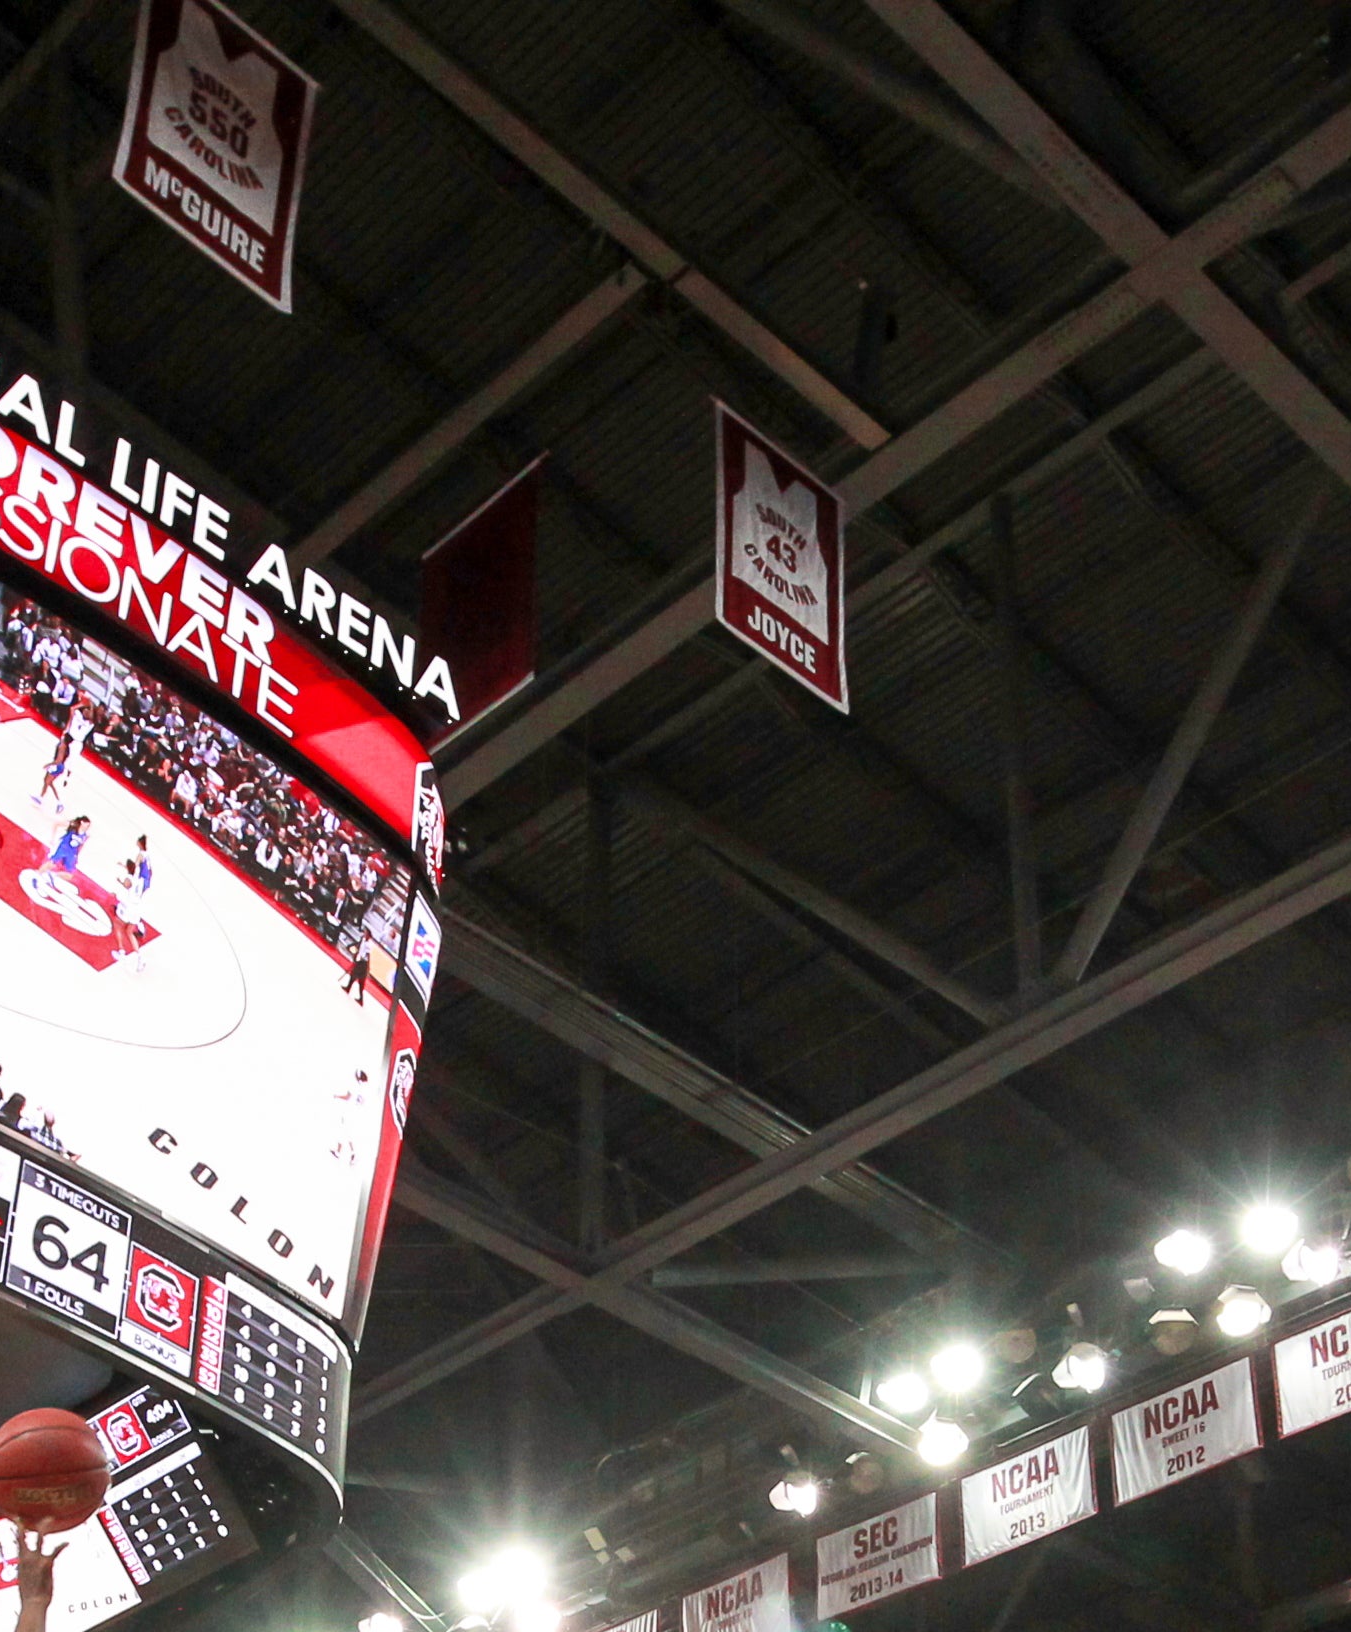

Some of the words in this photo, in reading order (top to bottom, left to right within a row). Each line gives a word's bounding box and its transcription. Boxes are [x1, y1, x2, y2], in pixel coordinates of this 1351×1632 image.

[755, 502, 807, 549] SOUTH
[743, 542, 819, 606] CAROLINA
[766, 534, 797, 574] 43
[111, 437, 230, 562] LIFE
[248, 541, 461, 721] ARENA
[747, 605, 817, 674] JOYCE
[34, 1173, 45, 1188] 3
[50, 1181, 120, 1228] TIMEOUTS
[31, 1214, 109, 1293] 64
[22, 1276, 30, 1290] 1
[34, 1283, 85, 1317] FOULS
[134, 1334, 178, 1366] BONUS
[1143, 1380, 1219, 1439] NCAA
[1161, 1427, 1190, 1448] SWEET
[1194, 1421, 1205, 1434] 16
[992, 1446, 1061, 1503] NCAA
[1167, 1446, 1206, 1476] 2012
[1000, 1484, 1055, 1516] TOURNAMENT
[853, 1516, 898, 1559] SEC
[1010, 1512, 1046, 1540] 2013
[706, 1572, 763, 1621] NCAA
[850, 1568, 903, 1602] 2013-14
